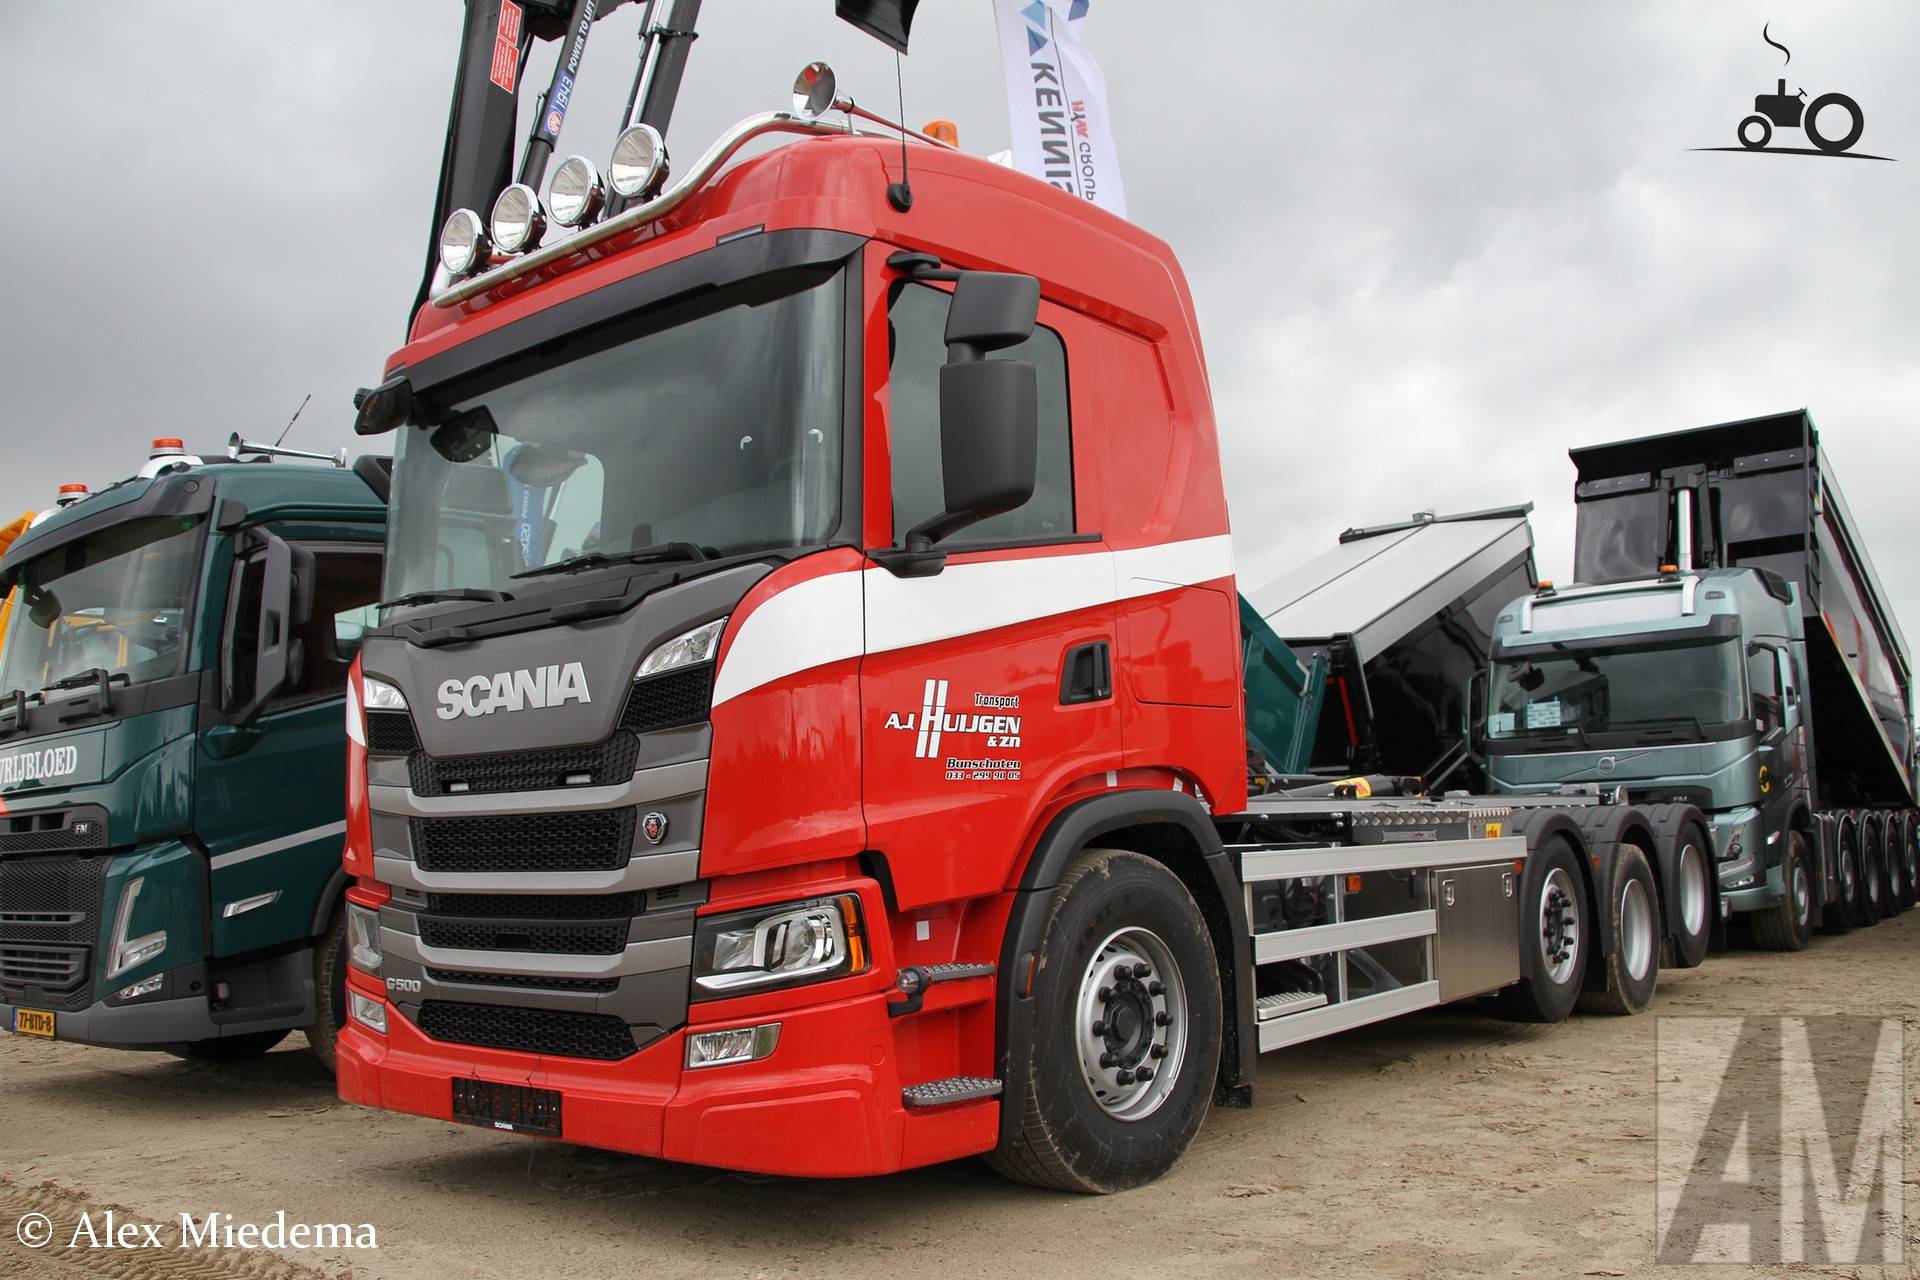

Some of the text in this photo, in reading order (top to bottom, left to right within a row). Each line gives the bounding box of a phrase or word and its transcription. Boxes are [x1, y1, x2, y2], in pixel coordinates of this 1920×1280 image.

[556, 75, 573, 110] 1943
[568, 35, 584, 73] POWER
[579, 20, 589, 35] TO
[584, 0, 595, 21] LIFT
[436, 661, 592, 720] SCANIA
[975, 692, 1019, 709] Transport
[987, 736, 998, 747] &
[946, 757, 1021, 769] Bunschoten
[946, 770, 965, 780] 033
[387, 977, 421, 992] G500
